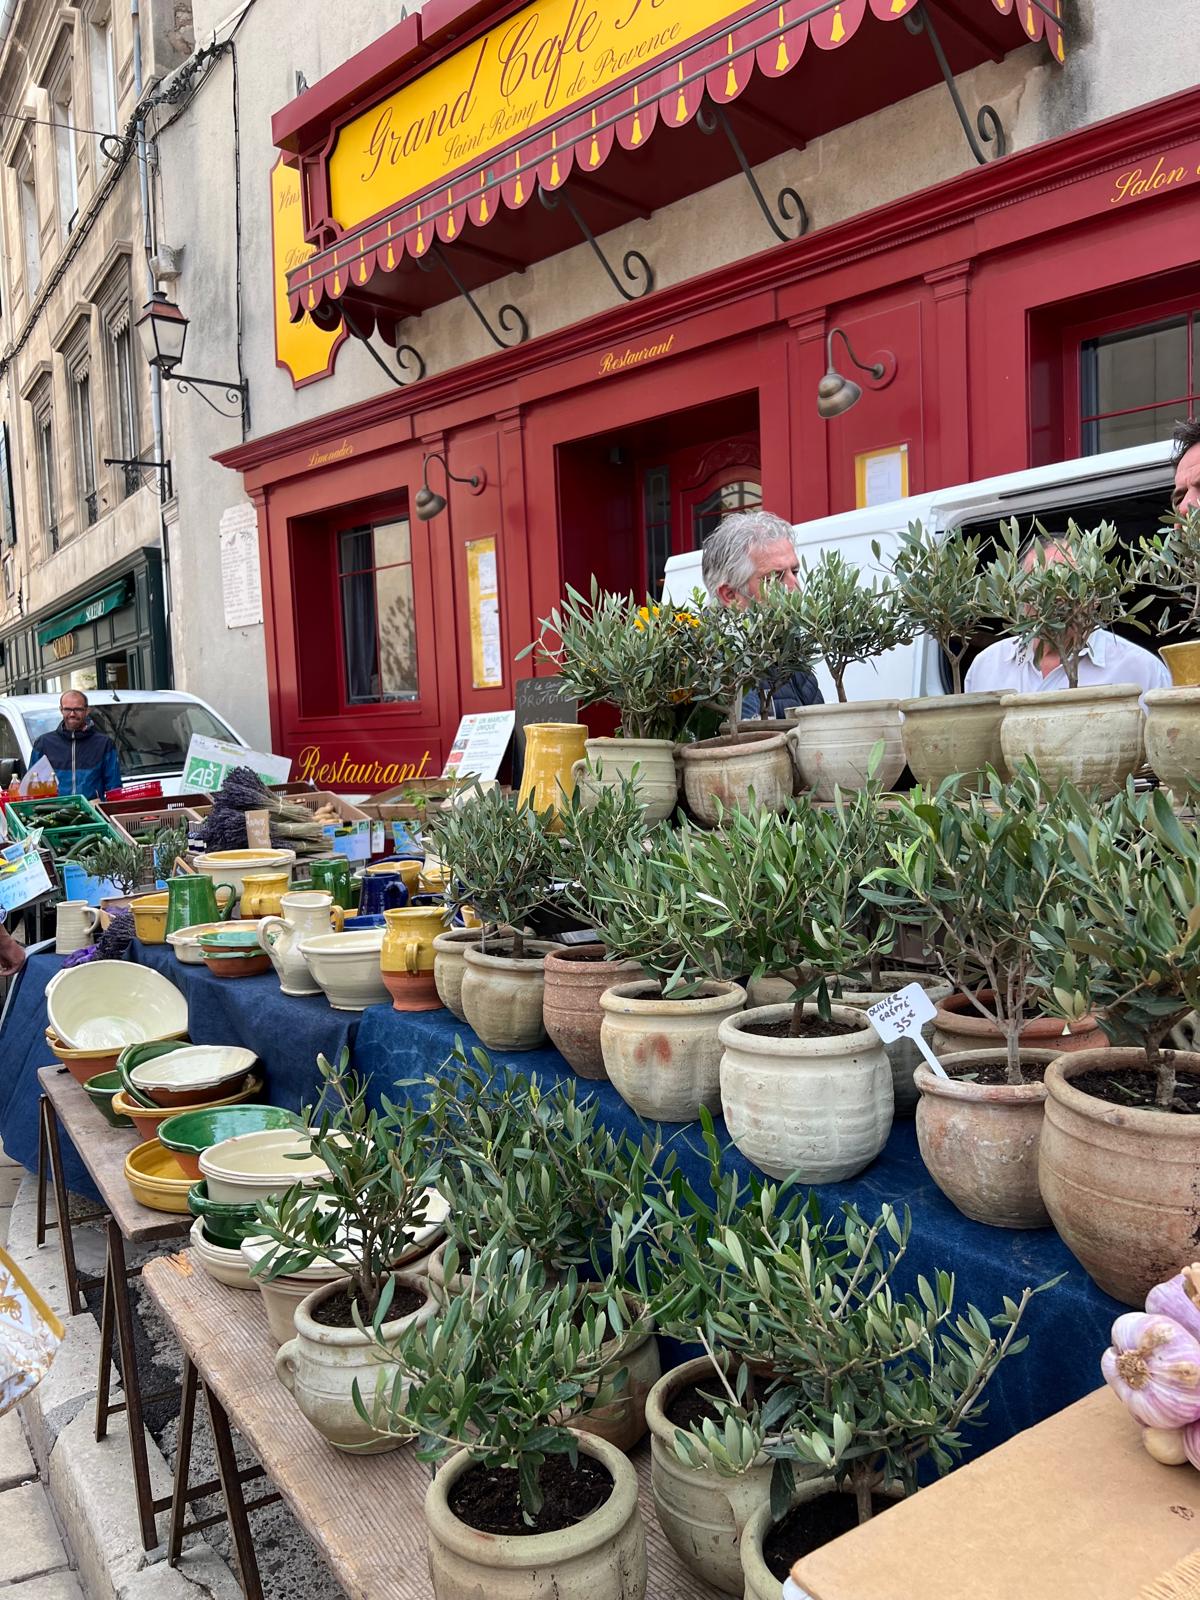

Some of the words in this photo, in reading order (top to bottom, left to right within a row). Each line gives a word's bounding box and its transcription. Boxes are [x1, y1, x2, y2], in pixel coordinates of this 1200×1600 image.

[361, 37, 488, 182] Grand
[442, 125, 487, 166] Saint
[487, 100, 538, 142] Rémy
[566, 61, 587, 99] de
[592, 22, 681, 84] Provence
[1110, 156, 1188, 203] Salon
[598, 333, 674, 375] Restaurant
[187, 766, 215, 787] AB
[295, 745, 432, 784] Restaurant
[868, 993, 902, 1017] OLIVIER
[893, 1010, 916, 1033] 35€
